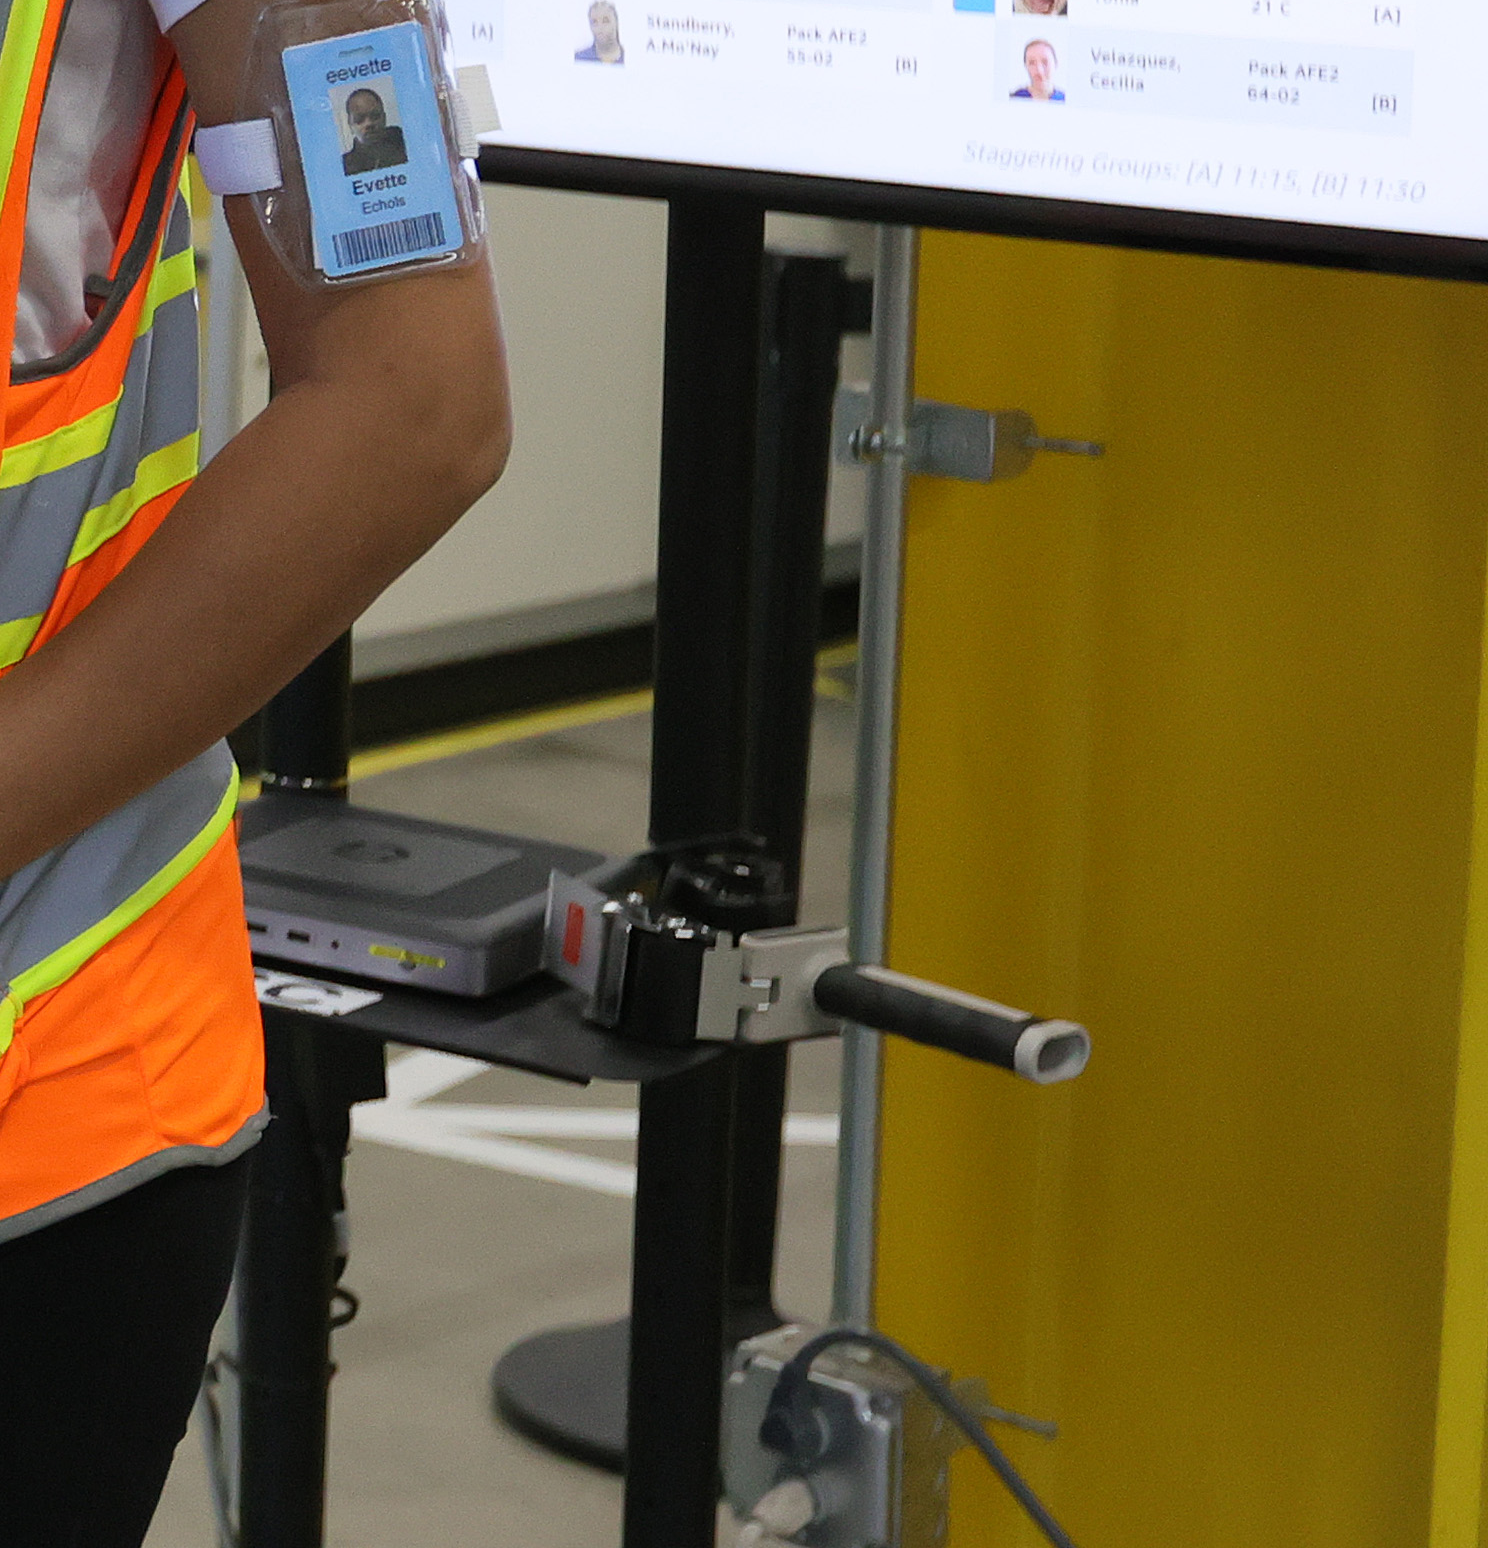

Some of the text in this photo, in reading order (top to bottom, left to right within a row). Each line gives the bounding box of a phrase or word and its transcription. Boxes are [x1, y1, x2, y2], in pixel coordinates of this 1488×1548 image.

[1372, 5, 1402, 26] [A]
[469, 22, 495, 42] [A]
[785, 25, 867, 44] Pack AFE2
[326, 56, 392, 84] eevette
[1088, 47, 1183, 73] Velazquez,
[1087, 71, 1146, 92] Cecilia
[1246, 60, 1340, 82] Pack AFE2
[961, 140, 1084, 174] Staggering
[1090, 151, 1181, 182] Groups:
[1185, 160, 1225, 187] [A]
[1309, 172, 1349, 198] [B]
[1356, 173, 1428, 202] 11:30
[352, 174, 408, 196] Evette
[362, 196, 407, 215] Echols
